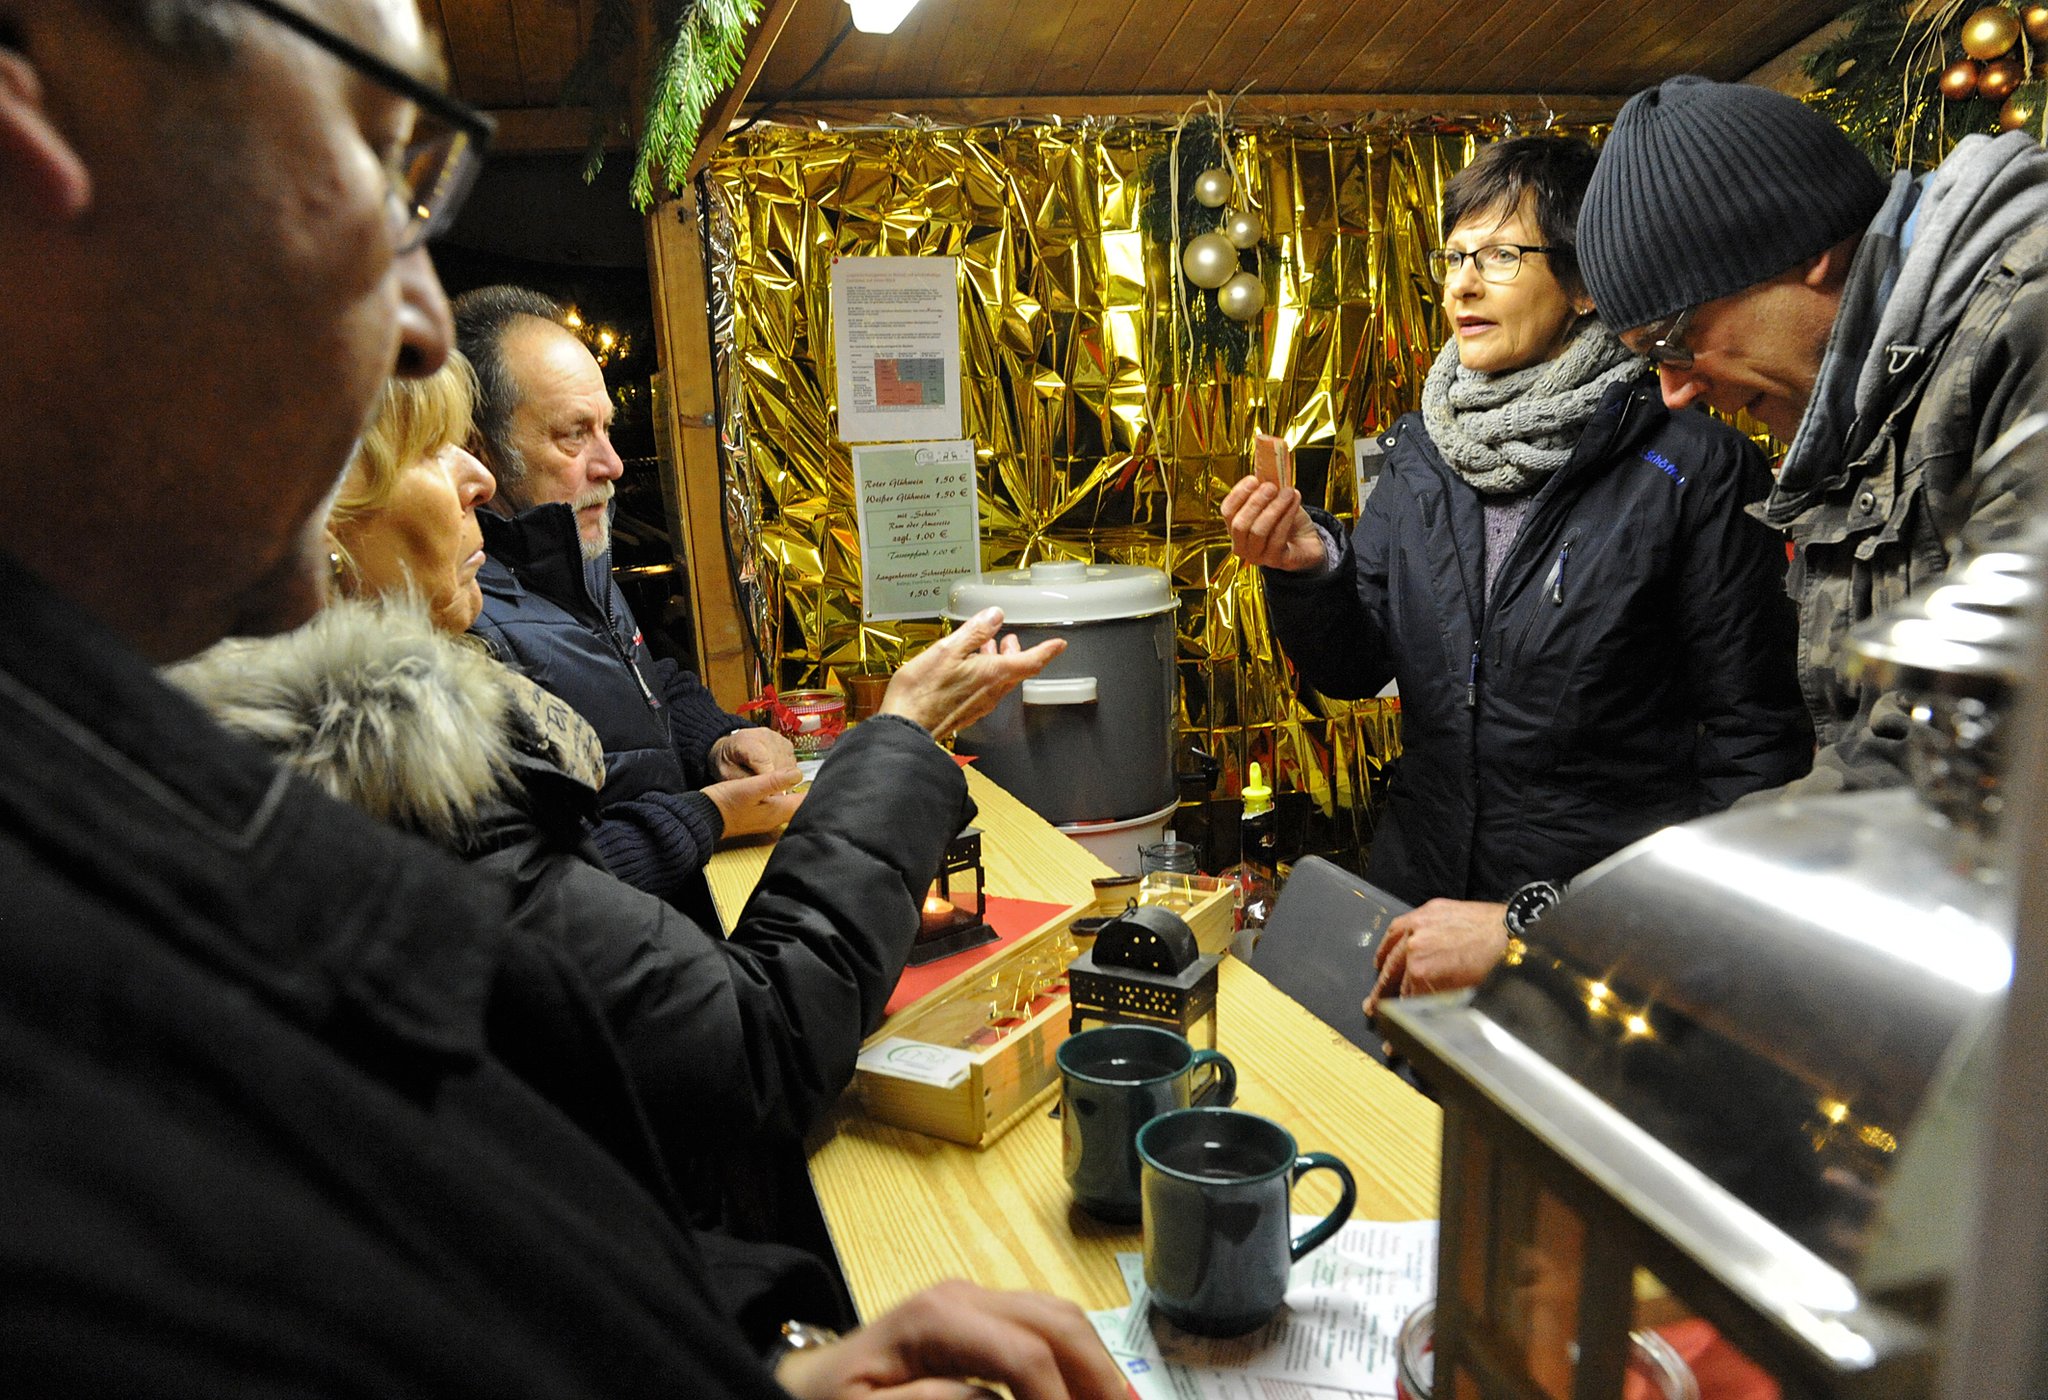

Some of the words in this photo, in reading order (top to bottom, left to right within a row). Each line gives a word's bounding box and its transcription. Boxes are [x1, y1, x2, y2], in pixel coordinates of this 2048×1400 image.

[865, 480, 886, 490] Roter
[889, 478, 924, 488] Glühwein
[959, 473, 967, 483] €
[865, 495, 893, 504] Weißer
[896, 493, 931, 503] Glühwein
[960, 488, 968, 497] €
[889, 522, 904, 531] Rum
[906, 521, 919, 529] oder
[939, 529, 948, 539] €
[933, 587, 941, 596] €
